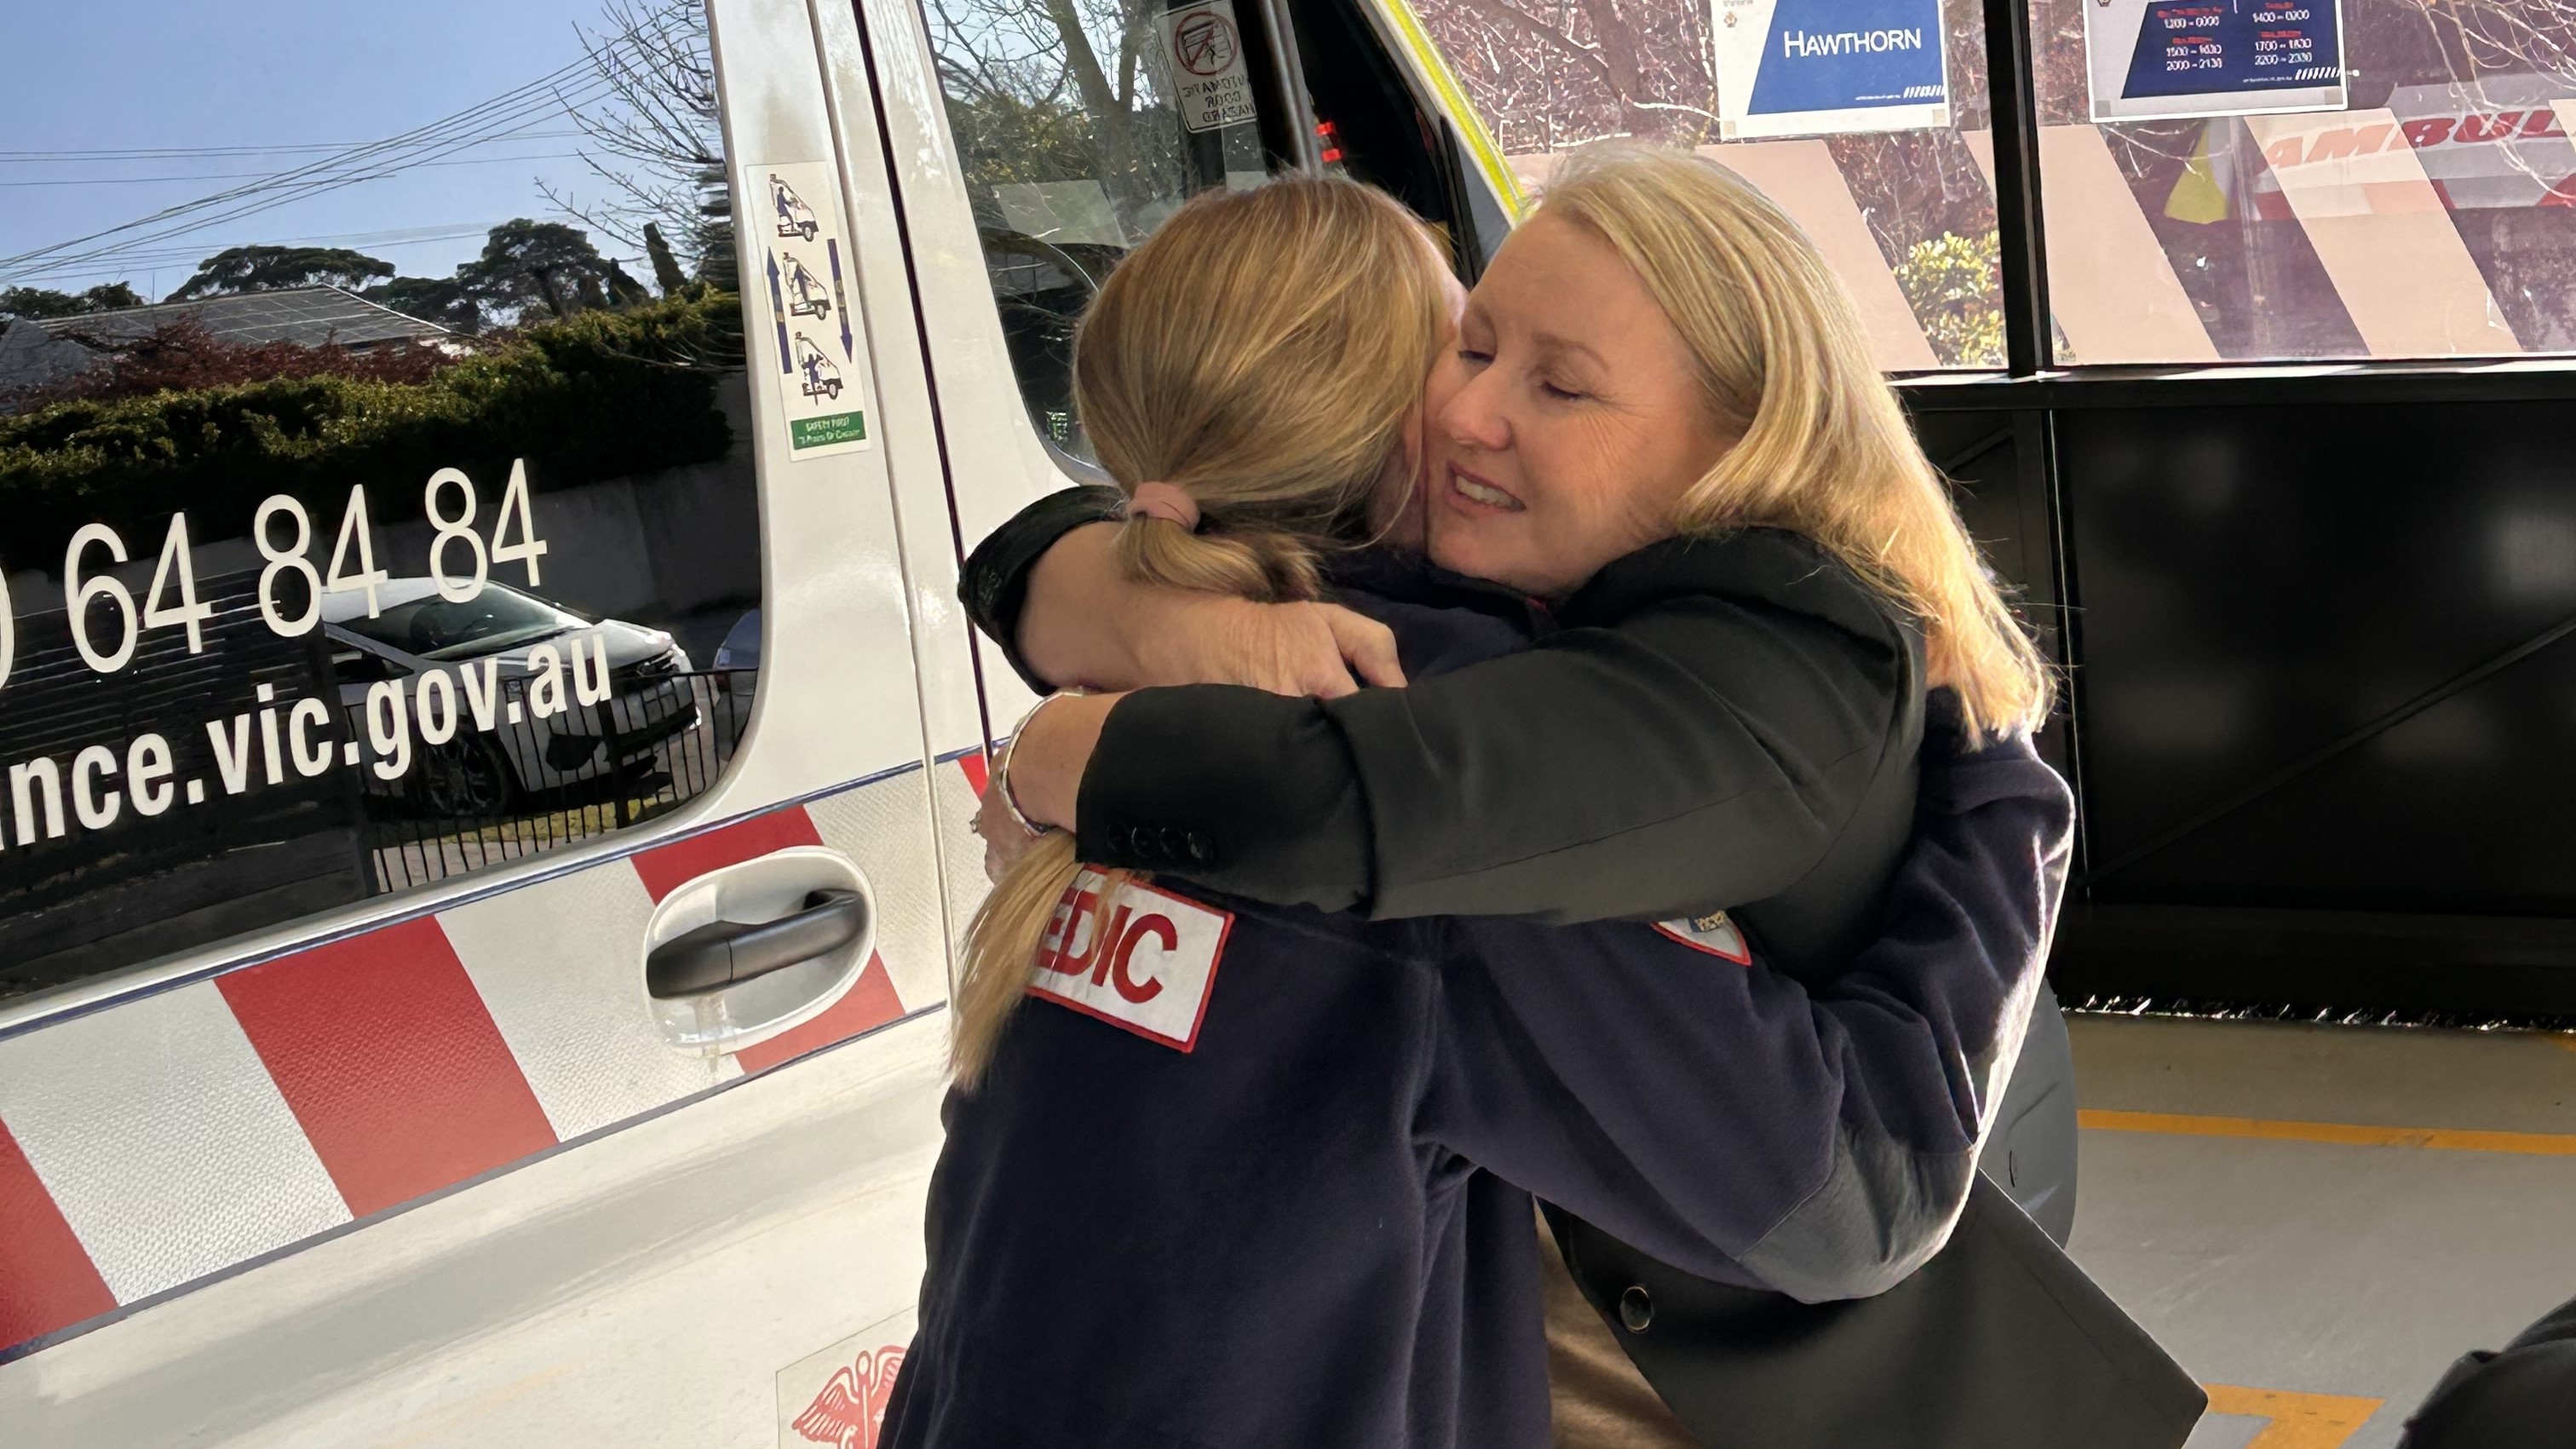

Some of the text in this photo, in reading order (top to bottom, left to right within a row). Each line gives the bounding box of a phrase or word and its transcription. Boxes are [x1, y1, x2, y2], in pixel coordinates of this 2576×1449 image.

[1784, 28, 1922, 58] HAWTHORN
[64, 511, 214, 673] 64
[254, 483, 388, 638] 84
[424, 457, 548, 604] 84
[0, 633, 612, 851] nce.vic.gov.au
